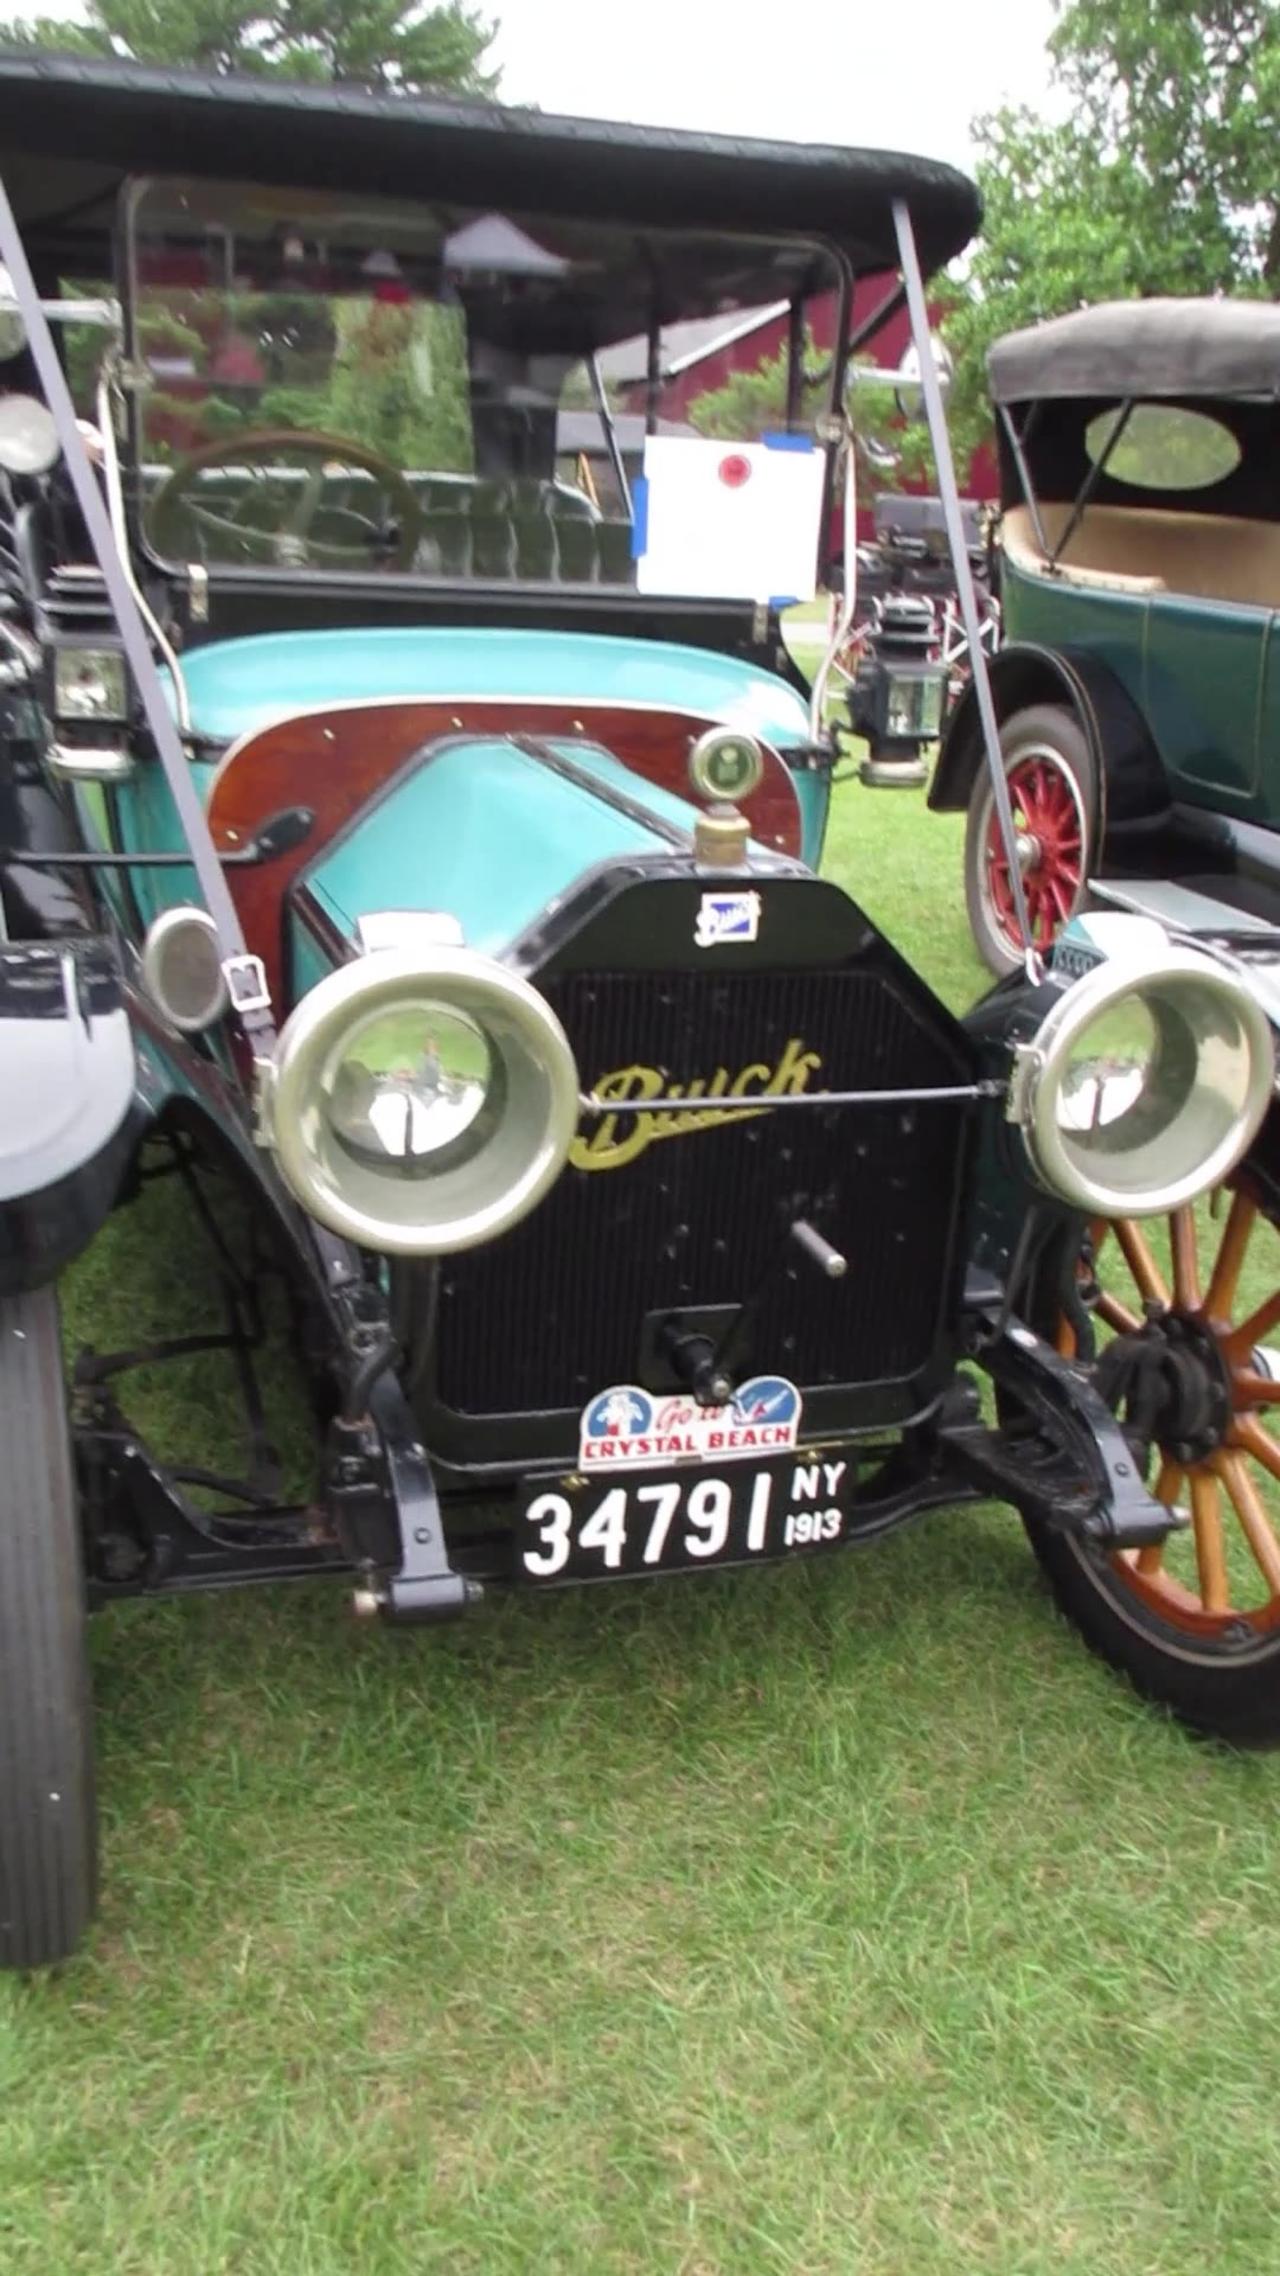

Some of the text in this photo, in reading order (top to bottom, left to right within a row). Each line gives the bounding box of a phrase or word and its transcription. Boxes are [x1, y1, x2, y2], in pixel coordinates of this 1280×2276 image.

[569, 1039, 822, 1171] Buick
[656, 1398, 692, 1434] Go
[585, 1427, 792, 1459] CRYSTAL BEACH
[791, 1461, 847, 1501] NY
[523, 1472, 772, 1576] 34791
[784, 1507, 842, 1547] 1913
